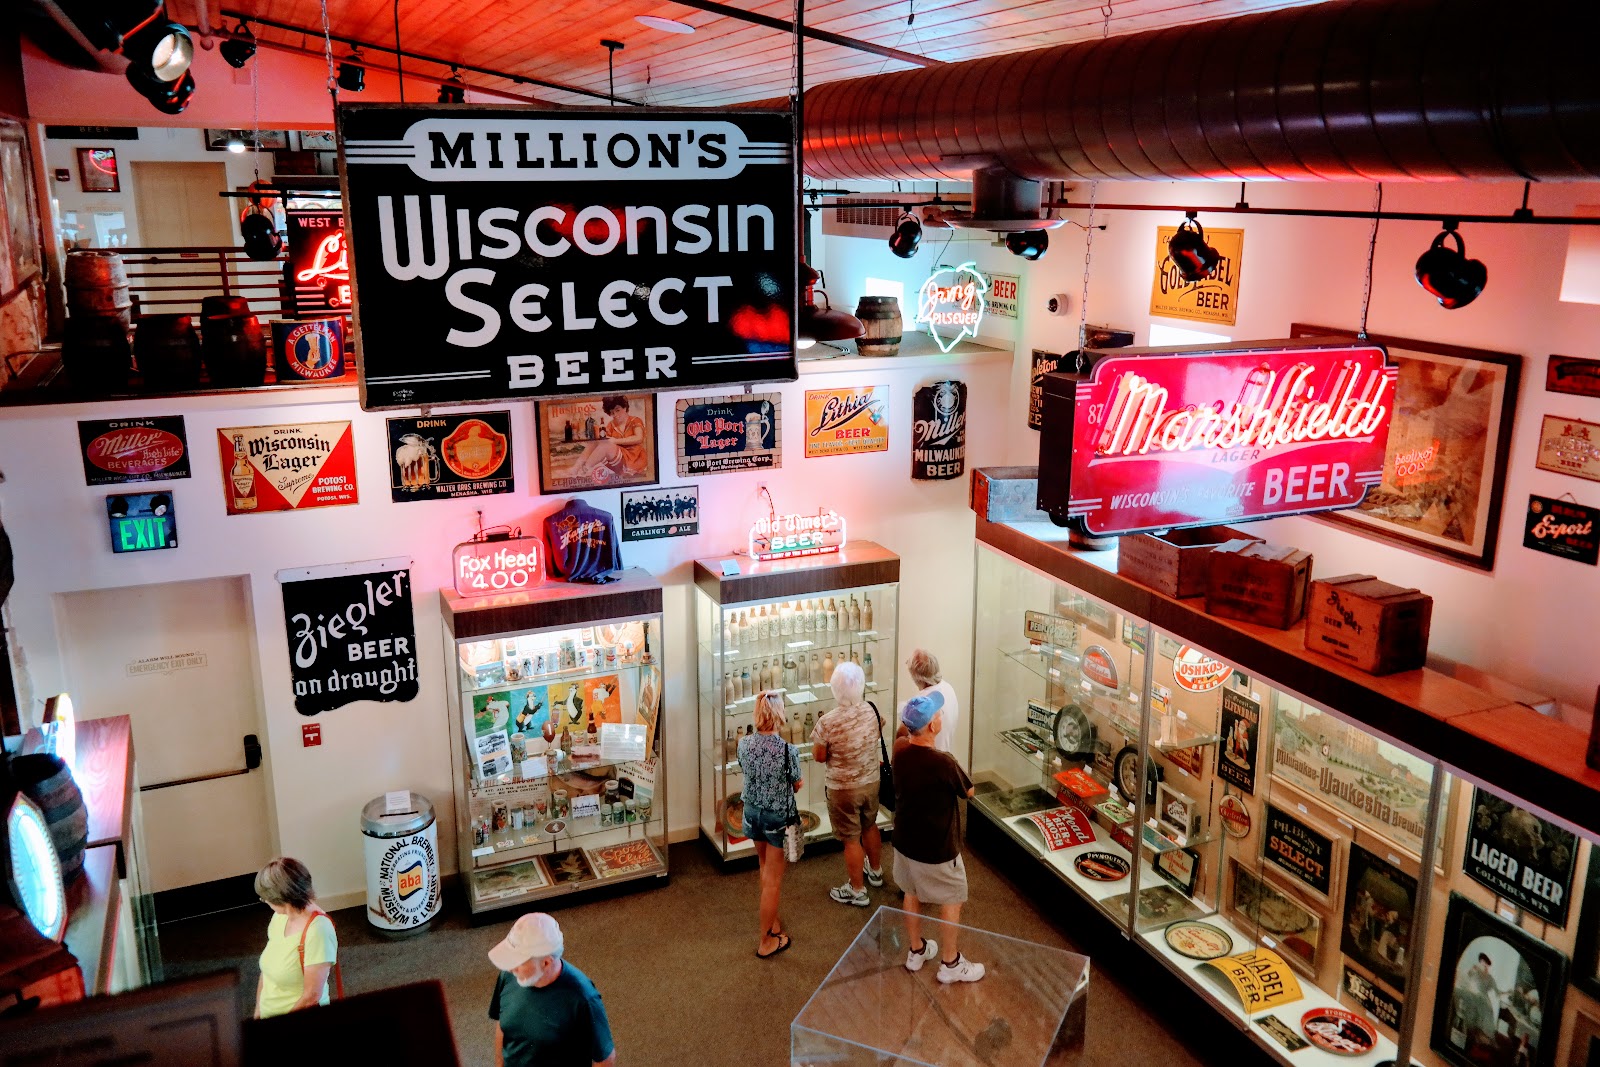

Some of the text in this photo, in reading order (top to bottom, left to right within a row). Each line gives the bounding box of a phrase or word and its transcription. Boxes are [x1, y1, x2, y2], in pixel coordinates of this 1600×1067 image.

[428, 129, 728, 169] MILLION'S
[298, 218, 331, 227] WEST
[377, 194, 775, 281] Wisconsin
[994, 279, 1017, 300] BEER
[1196, 291, 1230, 310] BEER
[291, 359, 337, 379] MILWAUKEE
[507, 346, 678, 389] BEER
[809, 392, 831, 400] DRINK
[707, 407, 734, 416] Drink
[811, 392, 873, 436] Lithia
[1104, 360, 1389, 456] Marshfield
[109, 420, 155, 428] DRINK
[416, 419, 447, 429] DRINK
[687, 417, 745, 439] Old Port
[836, 427, 871, 439] BEER
[95, 431, 163, 457] Miller
[248, 434, 331, 457] Wisconsin
[696, 435, 739, 450] Lager
[107, 458, 168, 469] BEVERAGES
[262, 453, 322, 472] Lager
[692, 460, 706, 468] Old
[706, 459, 722, 468] Port
[723, 457, 752, 465] Brewing
[1212, 450, 1260, 464] LAGER
[926, 462, 961, 477] BEER
[278, 473, 314, 491] Supreme
[312, 485, 343, 494] BREWING
[318, 476, 347, 485] POTOSI
[436, 484, 456, 493] WALTER
[473, 480, 498, 490] BREWING
[1263, 462, 1350, 505] BEER
[120, 518, 167, 551] EXIT
[631, 528, 666, 537] CARLING'S
[1531, 514, 1593, 539] Export
[771, 531, 824, 550] BEER
[460, 546, 537, 578] Fox Head
[291, 570, 407, 668] Ziegler
[348, 637, 411, 662] BEER
[129, 656, 203, 674] EMERGENCY EXIT ONLY
[1180, 661, 1227, 676] OSHKOS
[295, 657, 416, 696] on draught
[1191, 680, 1219, 690] BEER
[1221, 763, 1251, 786] BEER
[380, 836, 437, 925] NATIONAL BREWERY MUSEUM & LIBRARY
[400, 873, 422, 889] aba
[1471, 837, 1563, 906] LAGER BEER
[1232, 968, 1261, 1004] BEER
